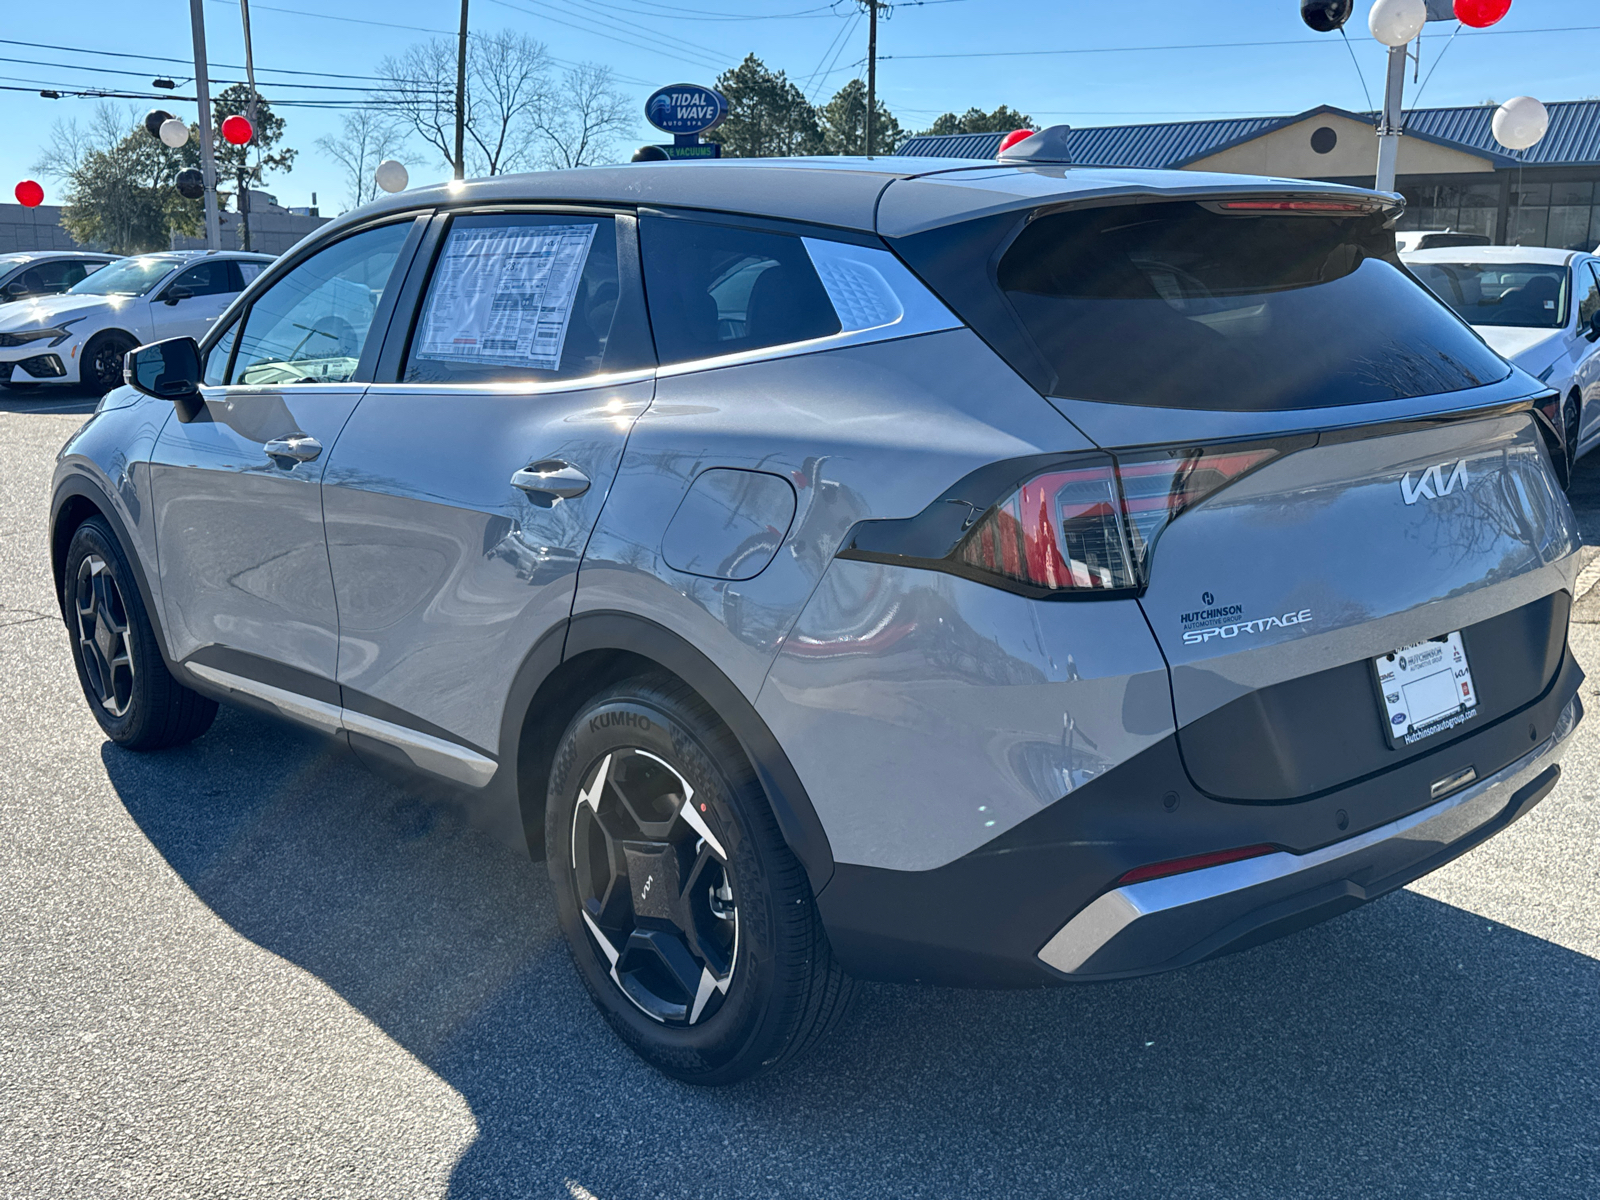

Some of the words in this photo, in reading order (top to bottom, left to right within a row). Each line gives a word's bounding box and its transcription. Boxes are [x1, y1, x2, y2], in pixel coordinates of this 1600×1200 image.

[671, 93, 706, 106] TIDAL
[676, 106, 714, 119] WAVE
[676, 147, 711, 157] VACUUMS
[1400, 457, 1469, 506] KIA
[1180, 604, 1243, 623] HUTCHINSON
[1183, 617, 1222, 630] AUTOMOTIVE
[1222, 614, 1243, 624] GROUP
[1182, 608, 1312, 644] SPORTAGE
[1407, 646, 1443, 666] HUTCHINSON
[589, 710, 651, 733] KUMHO
[1404, 709, 1477, 744] Hutchinsonautogroup.com
